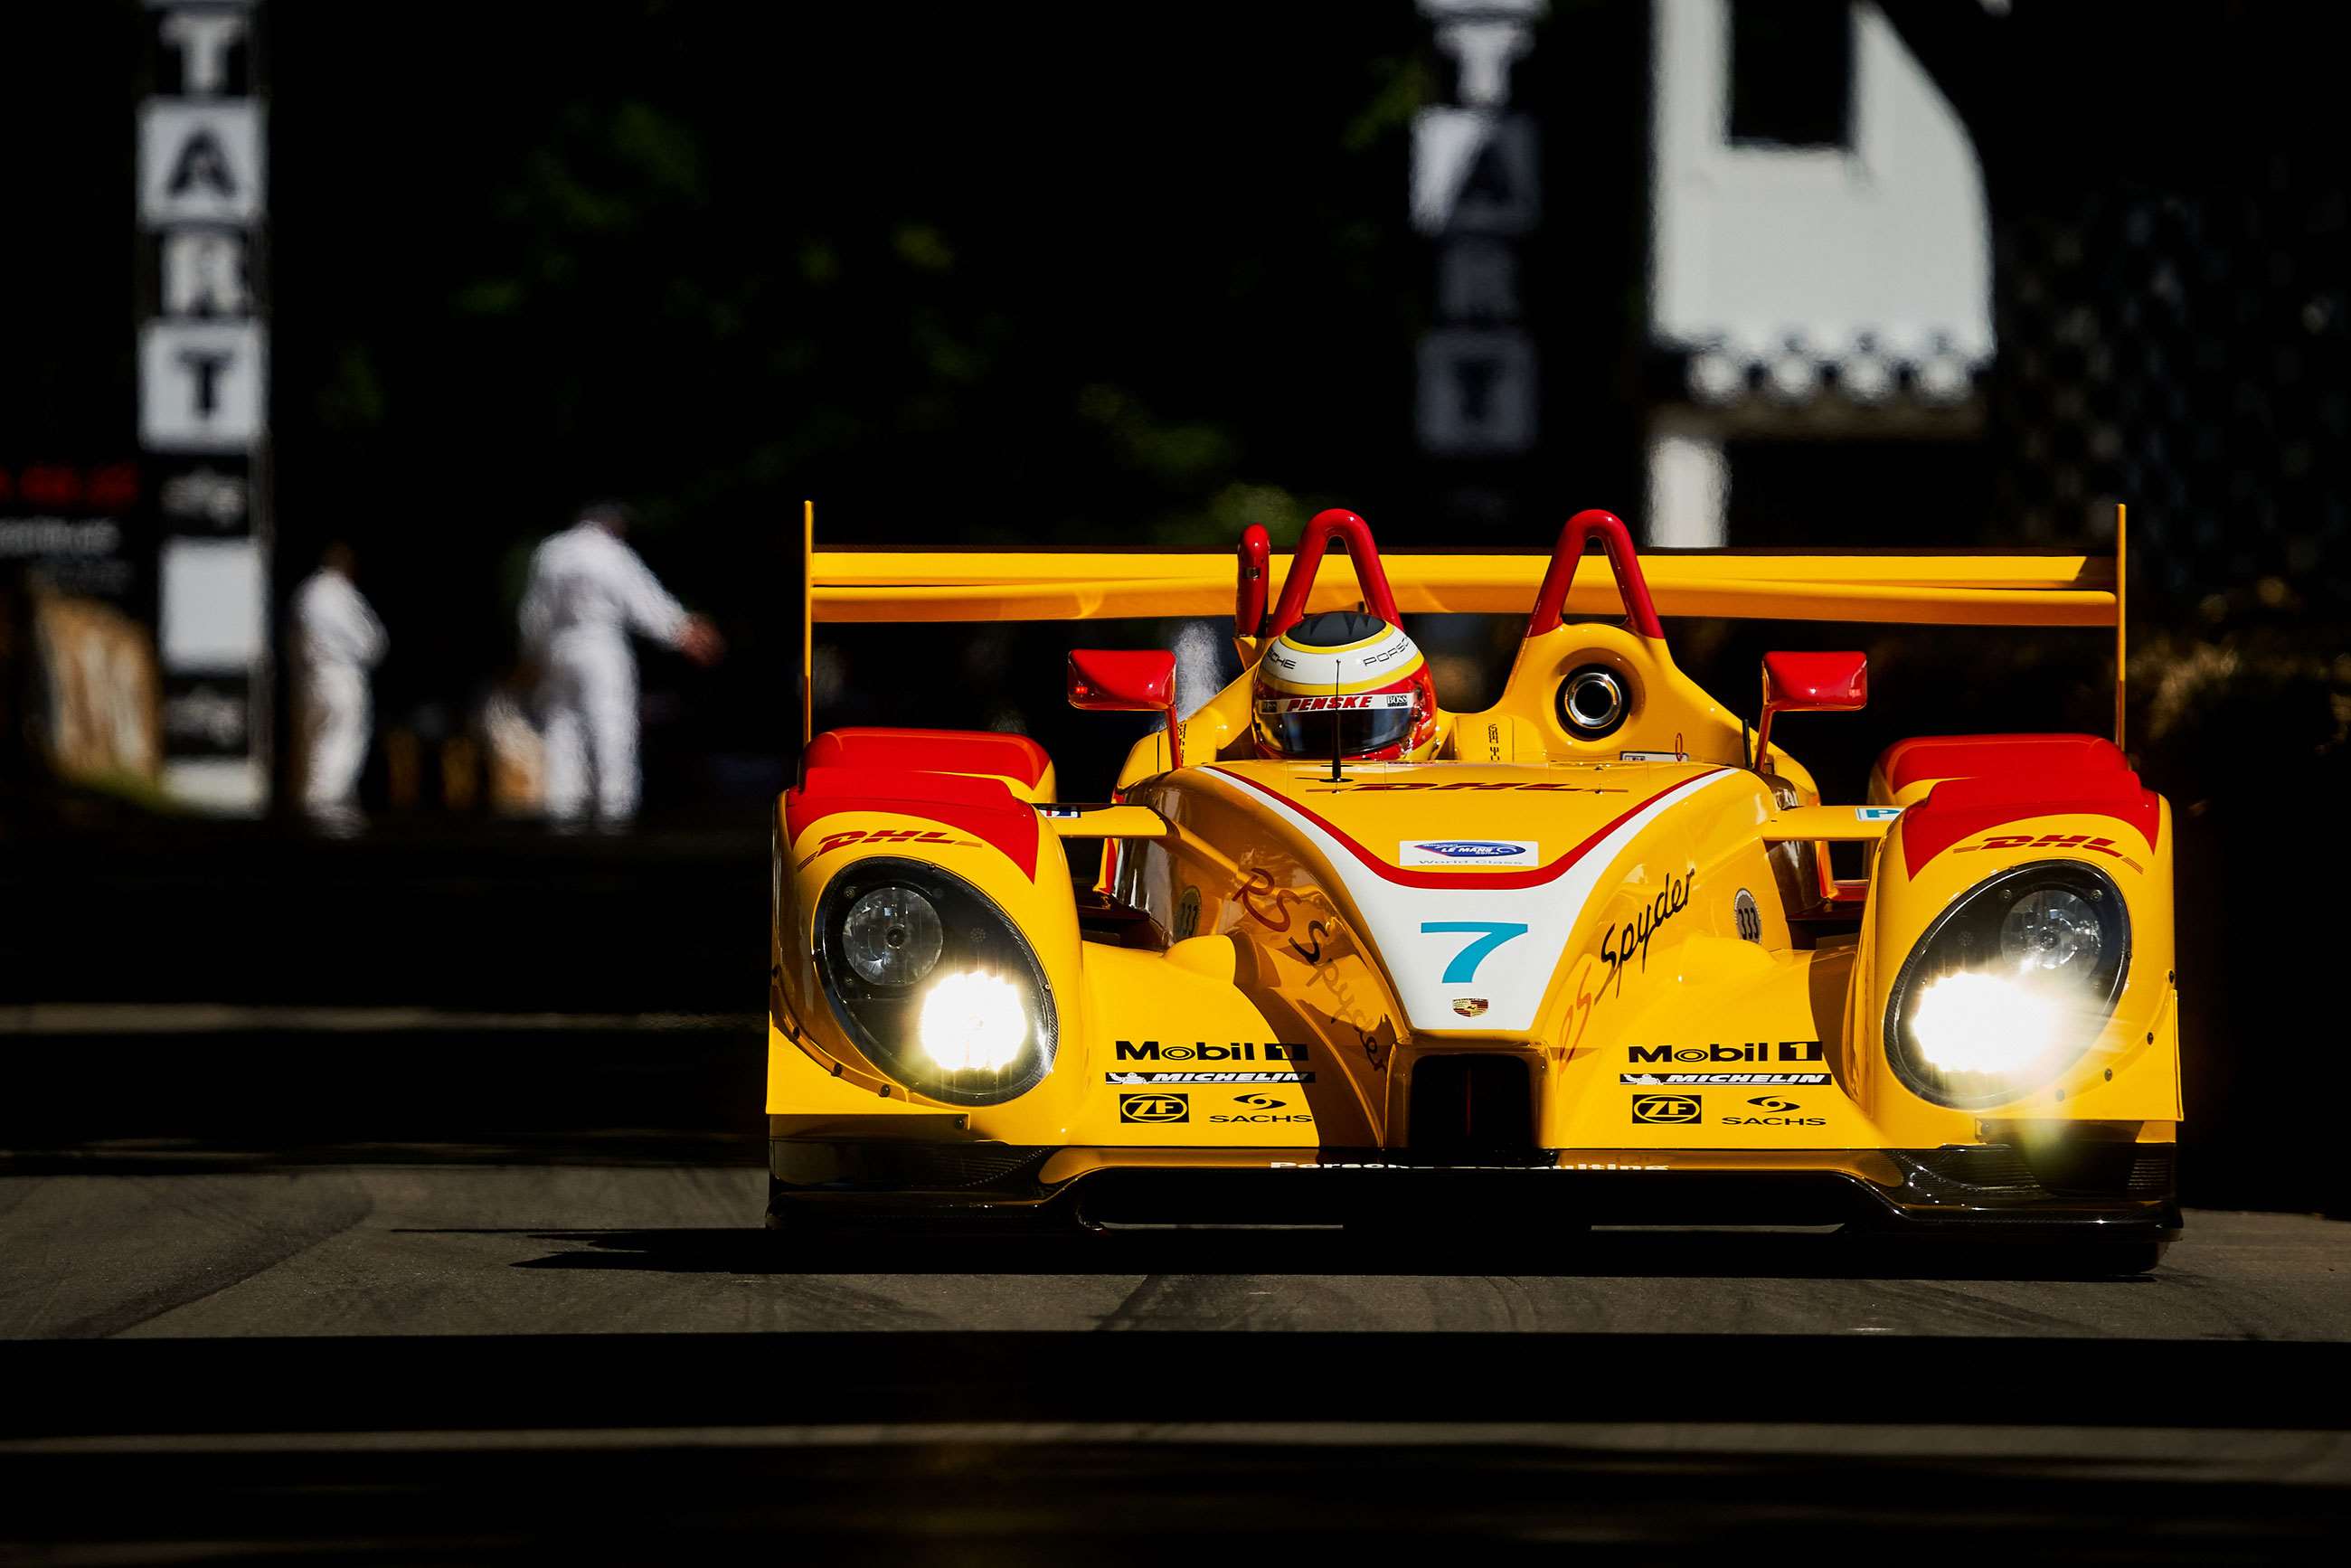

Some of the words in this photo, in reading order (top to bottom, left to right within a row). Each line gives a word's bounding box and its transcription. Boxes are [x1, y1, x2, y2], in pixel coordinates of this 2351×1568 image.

[1286, 695, 1373, 712] PENSKE
[1350, 781, 1583, 793] DHL
[817, 829, 957, 858] DHL
[1980, 826, 2124, 859] DHL
[1232, 867, 1303, 933] RS
[1593, 867, 1695, 1006] Spyder
[1420, 921, 1529, 985] 7
[1115, 1040, 1256, 1061] Mobil
[1628, 1042, 1769, 1063] Mobil
[1151, 1072, 1308, 1082] MICHELIN
[1666, 1073, 1826, 1083] MICHELIN
[1209, 1114, 1313, 1123] SACHS
[1721, 1116, 1827, 1126] SACHS
